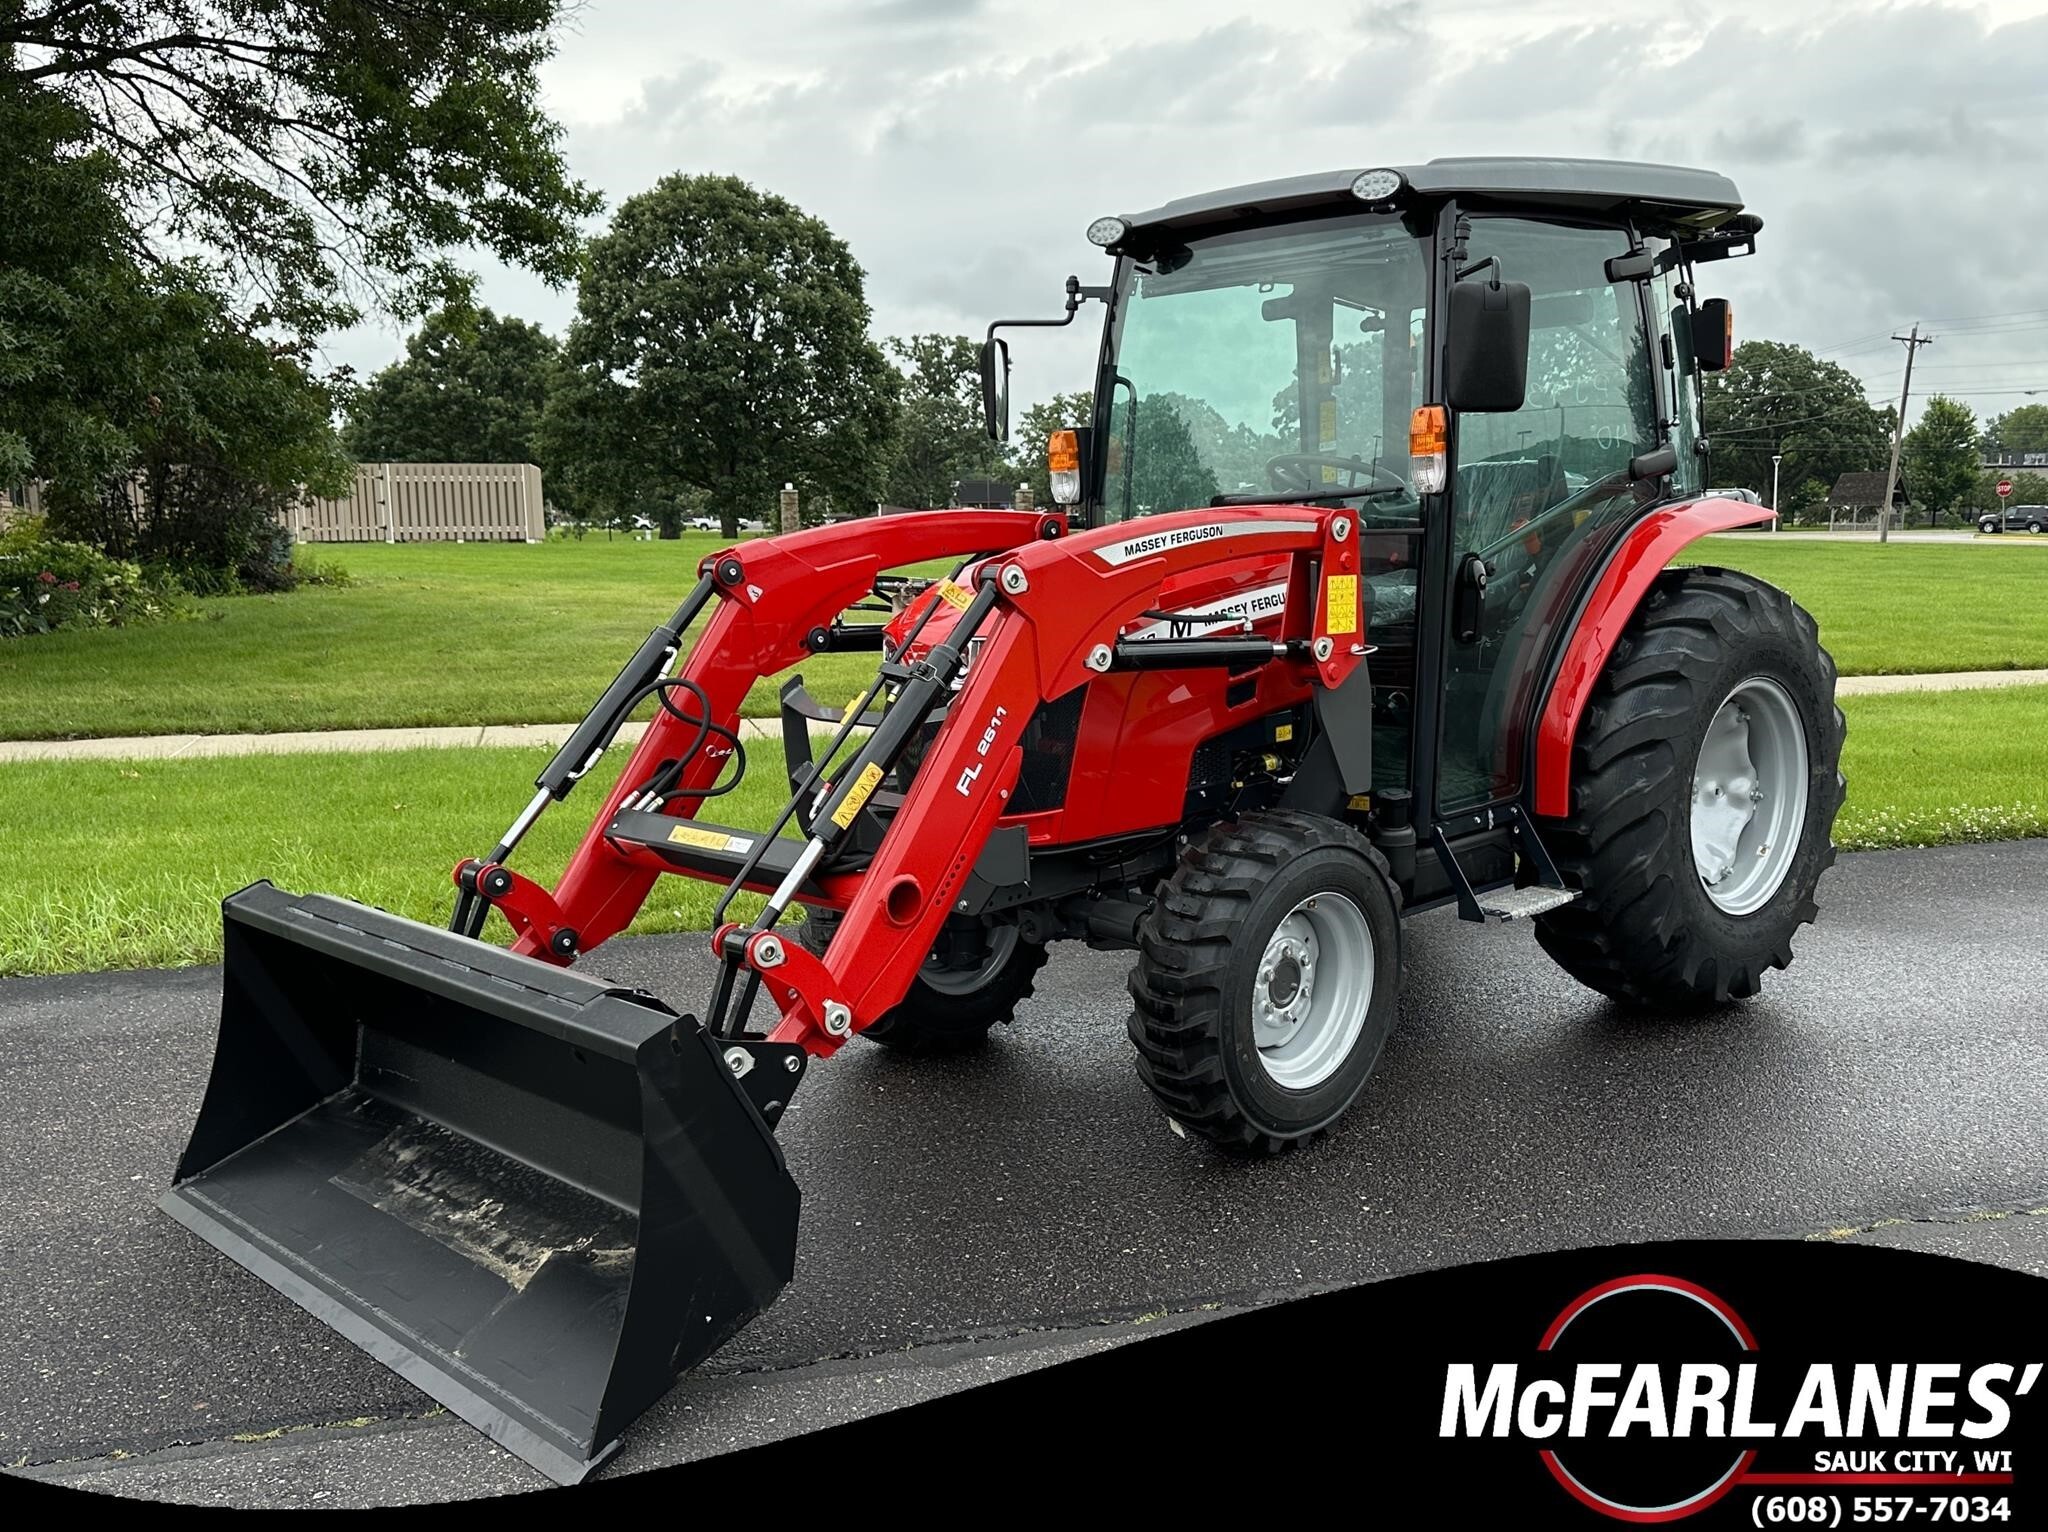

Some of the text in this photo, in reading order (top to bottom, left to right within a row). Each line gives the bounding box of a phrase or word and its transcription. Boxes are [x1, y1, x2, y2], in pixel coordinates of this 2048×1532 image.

[1124, 525, 1224, 557] MASSEY FERGUSON
[955, 705, 1008, 797] FL 2611
